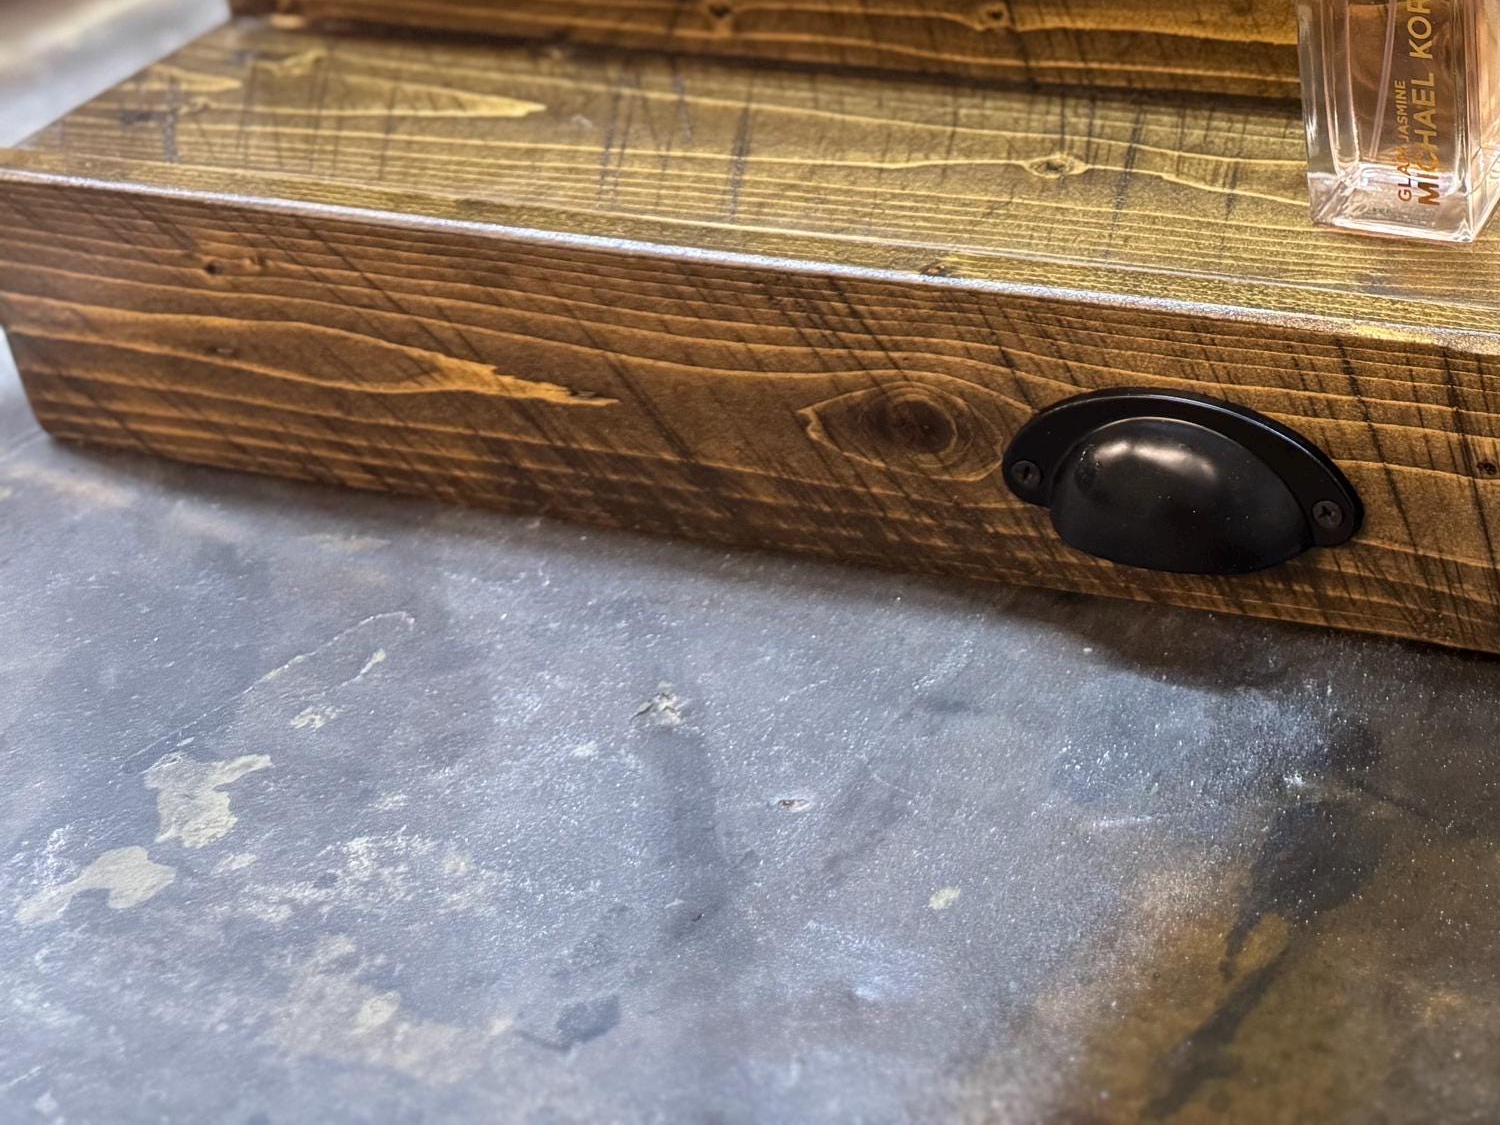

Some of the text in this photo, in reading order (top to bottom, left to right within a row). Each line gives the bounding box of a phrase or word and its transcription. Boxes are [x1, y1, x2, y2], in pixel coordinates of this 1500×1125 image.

[1395, 80, 1412, 202] GLAM JASMINE
[1411, 72, 1440, 206] MICHAEL
